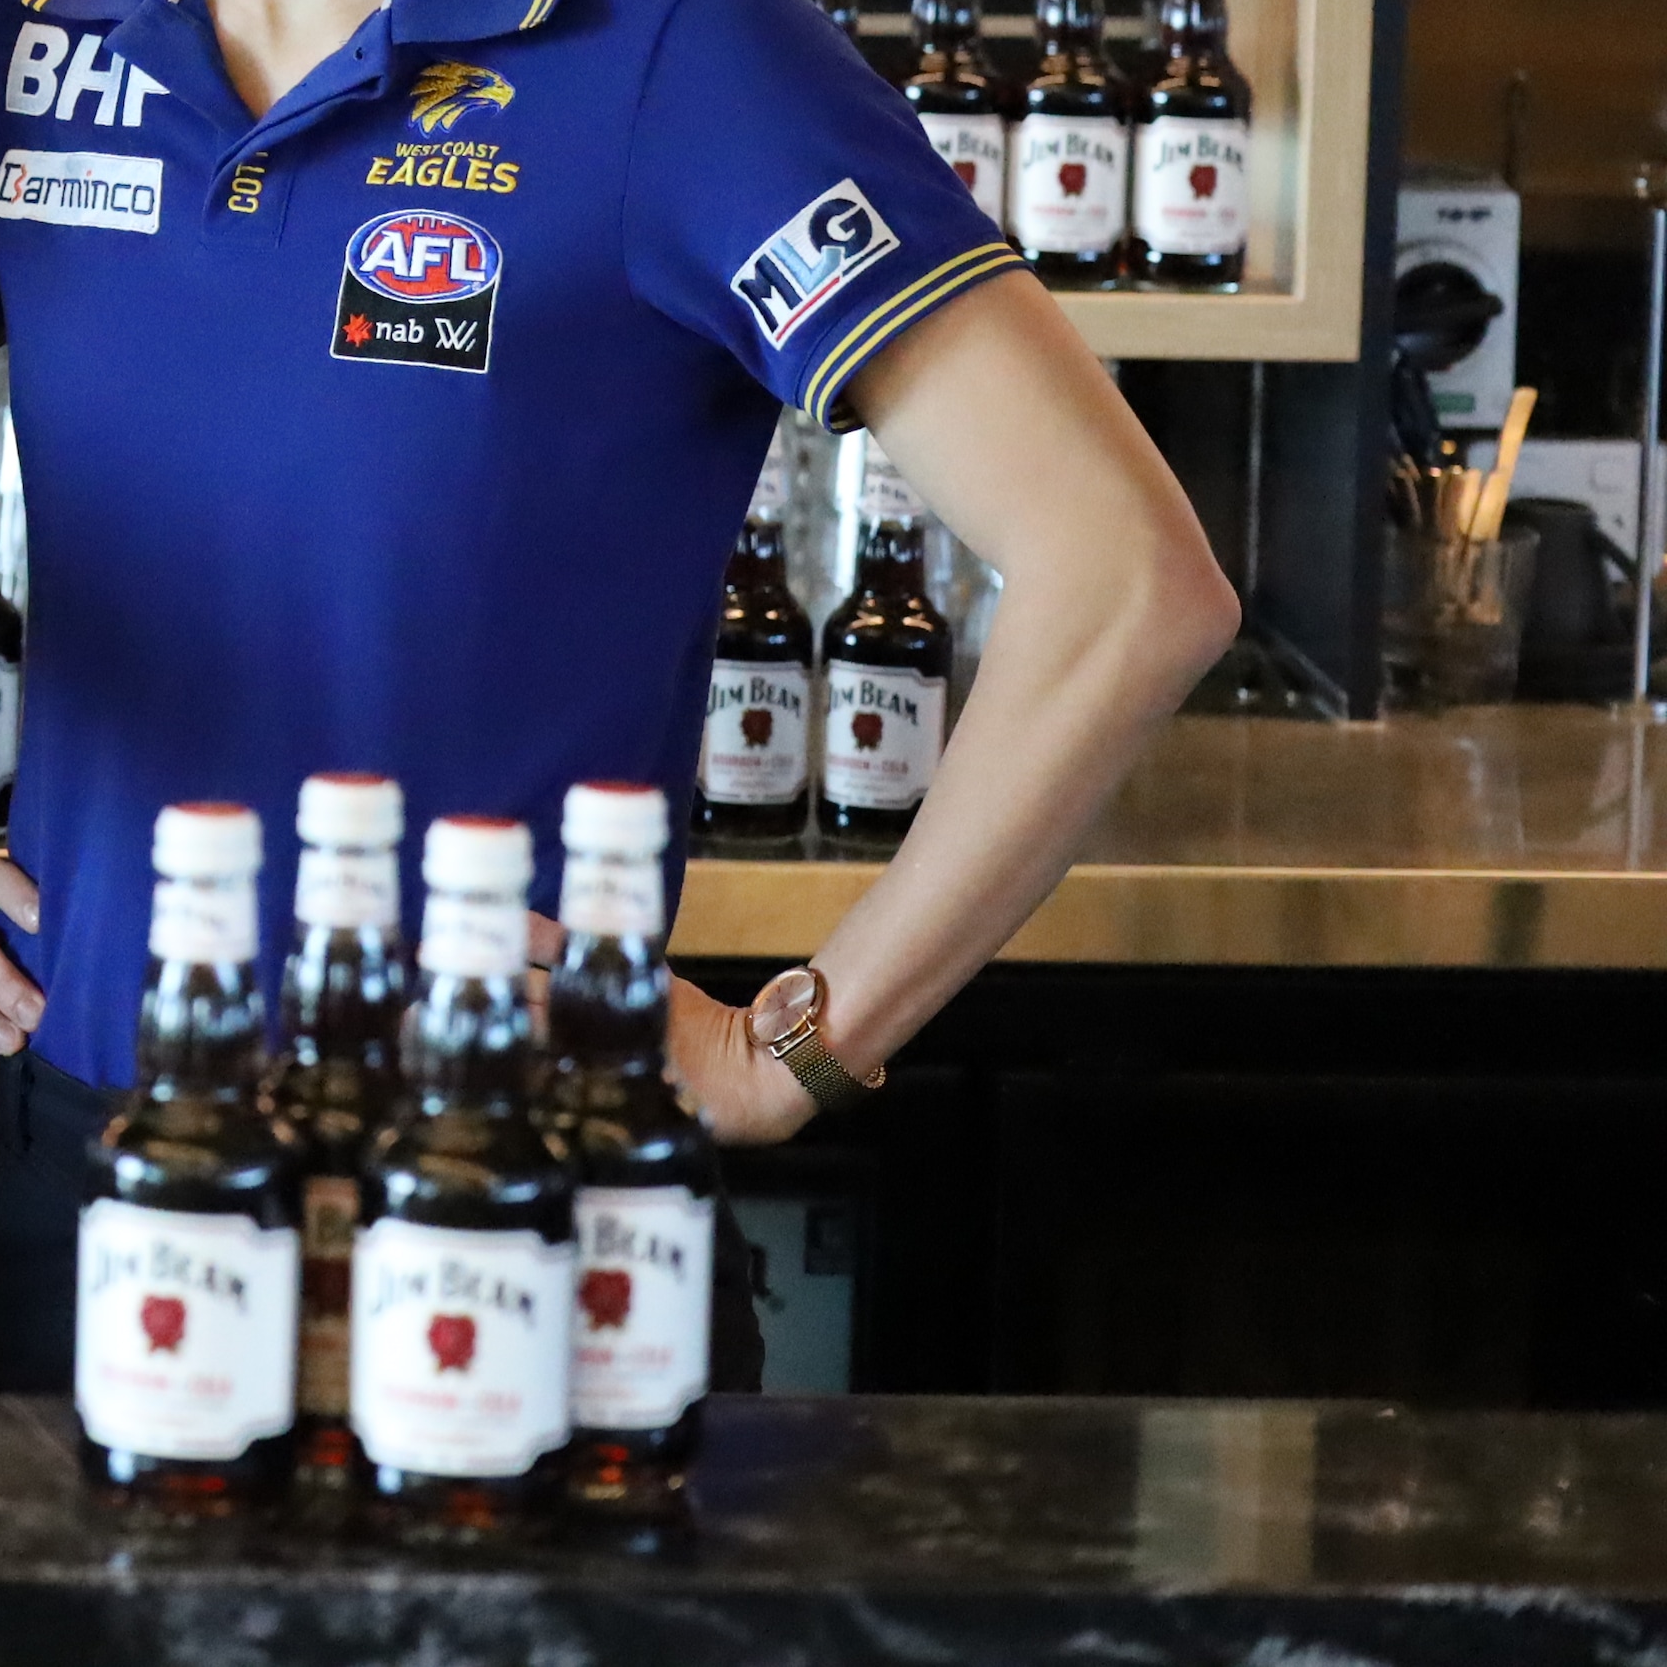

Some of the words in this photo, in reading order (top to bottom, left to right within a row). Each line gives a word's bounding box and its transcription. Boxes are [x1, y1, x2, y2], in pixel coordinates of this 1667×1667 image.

[395, 142, 441, 157] WEST
[441, 141, 500, 159] COAST
[366, 156, 520, 193] EAGLES
[359, 230, 486, 282] AFL
[738, 198, 873, 334] MLG
[375, 319, 424, 343] nab
[707, 683, 743, 718] JIM
[750, 675, 801, 719] BEAM
[860, 680, 918, 726] BEAM
